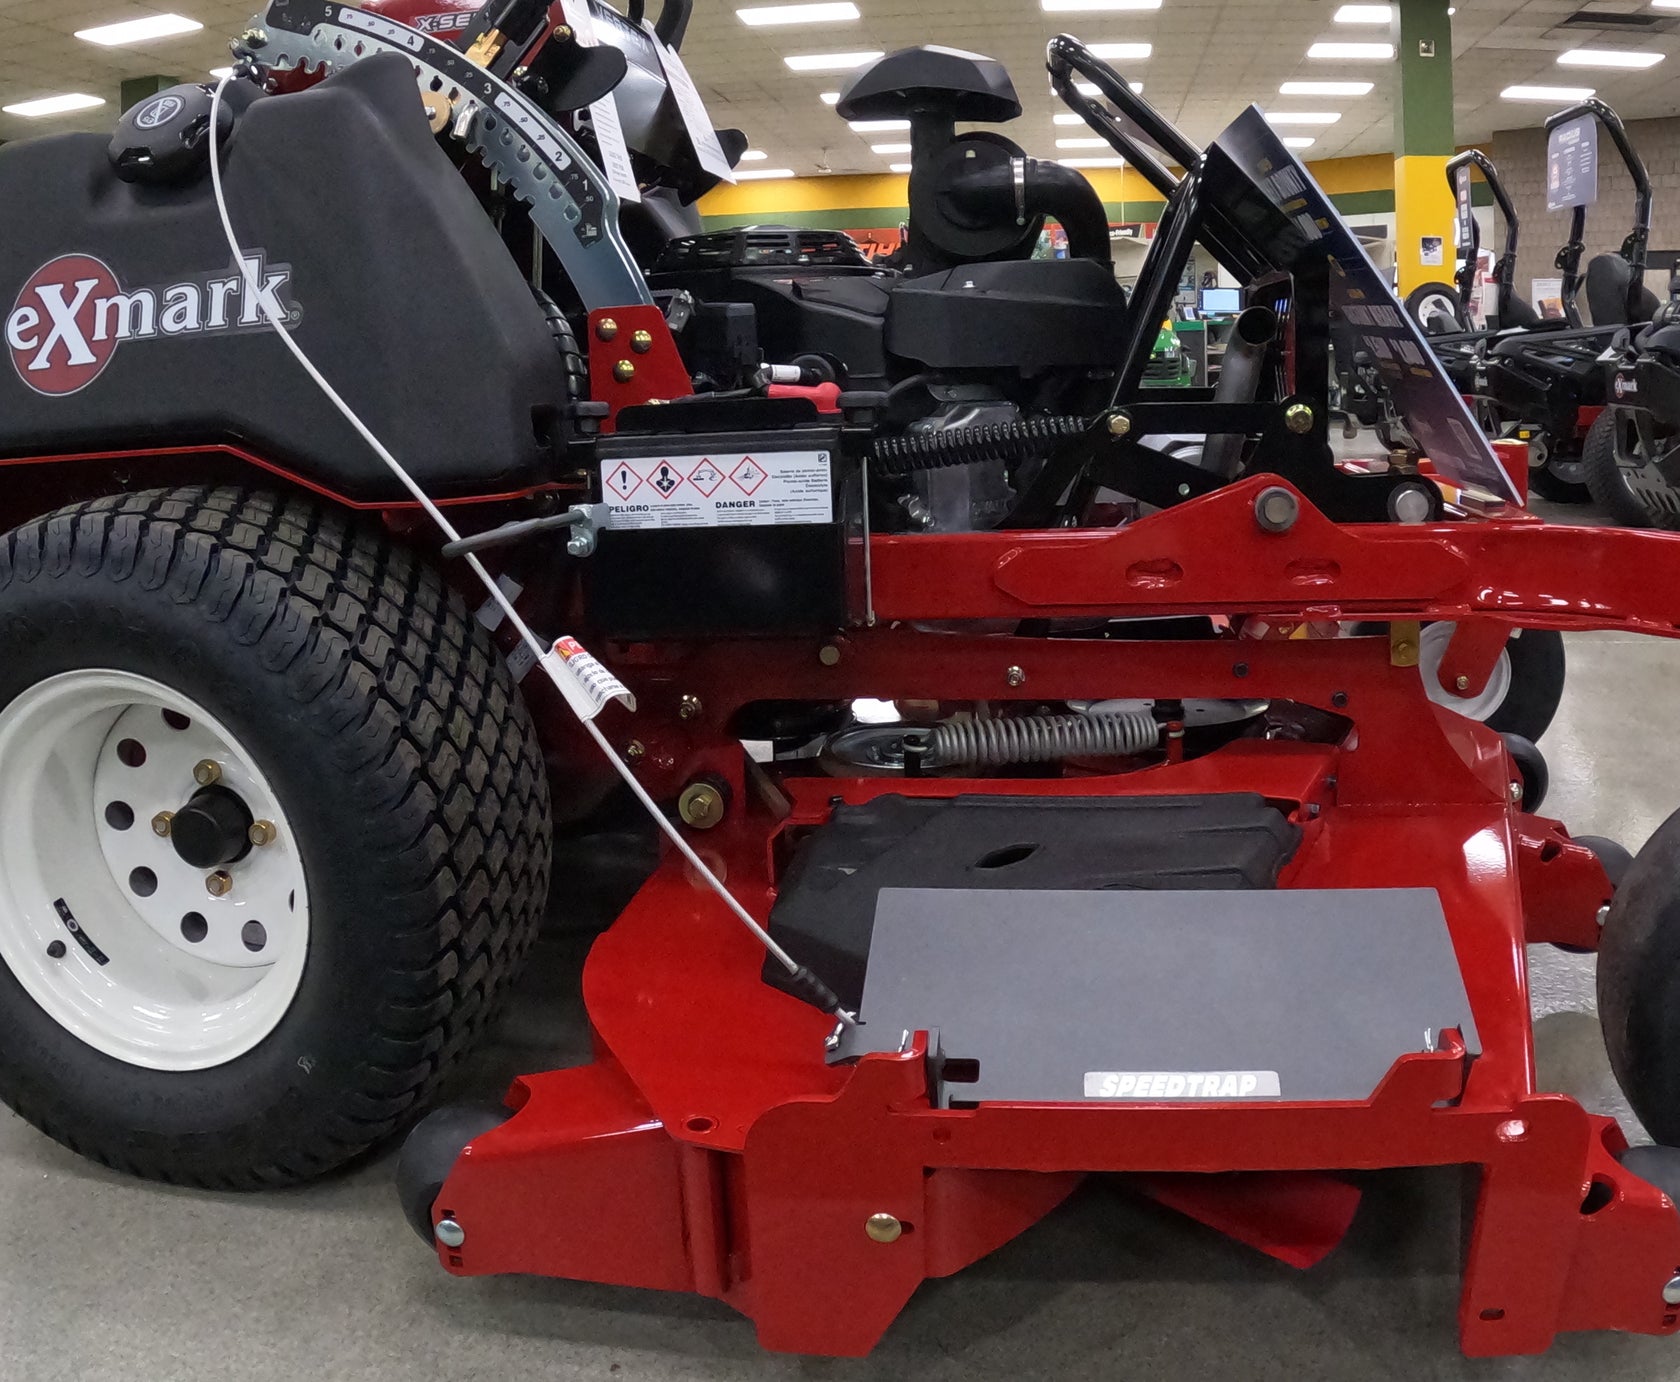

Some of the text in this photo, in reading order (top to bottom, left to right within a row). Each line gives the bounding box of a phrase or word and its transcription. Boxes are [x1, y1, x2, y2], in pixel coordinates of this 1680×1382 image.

[417, 12, 476, 31] X-SE
[325, 6, 333, 17] 5
[407, 35, 414, 46] 4
[484, 82, 492, 94] 3
[555, 151, 563, 162] 2
[582, 179, 588, 191] 1
[7, 258, 289, 371] eXmark
[609, 504, 649, 513] PELIGRO
[715, 500, 755, 509] DANGER
[1100, 1073, 1257, 1097] SPEEDTRAP
